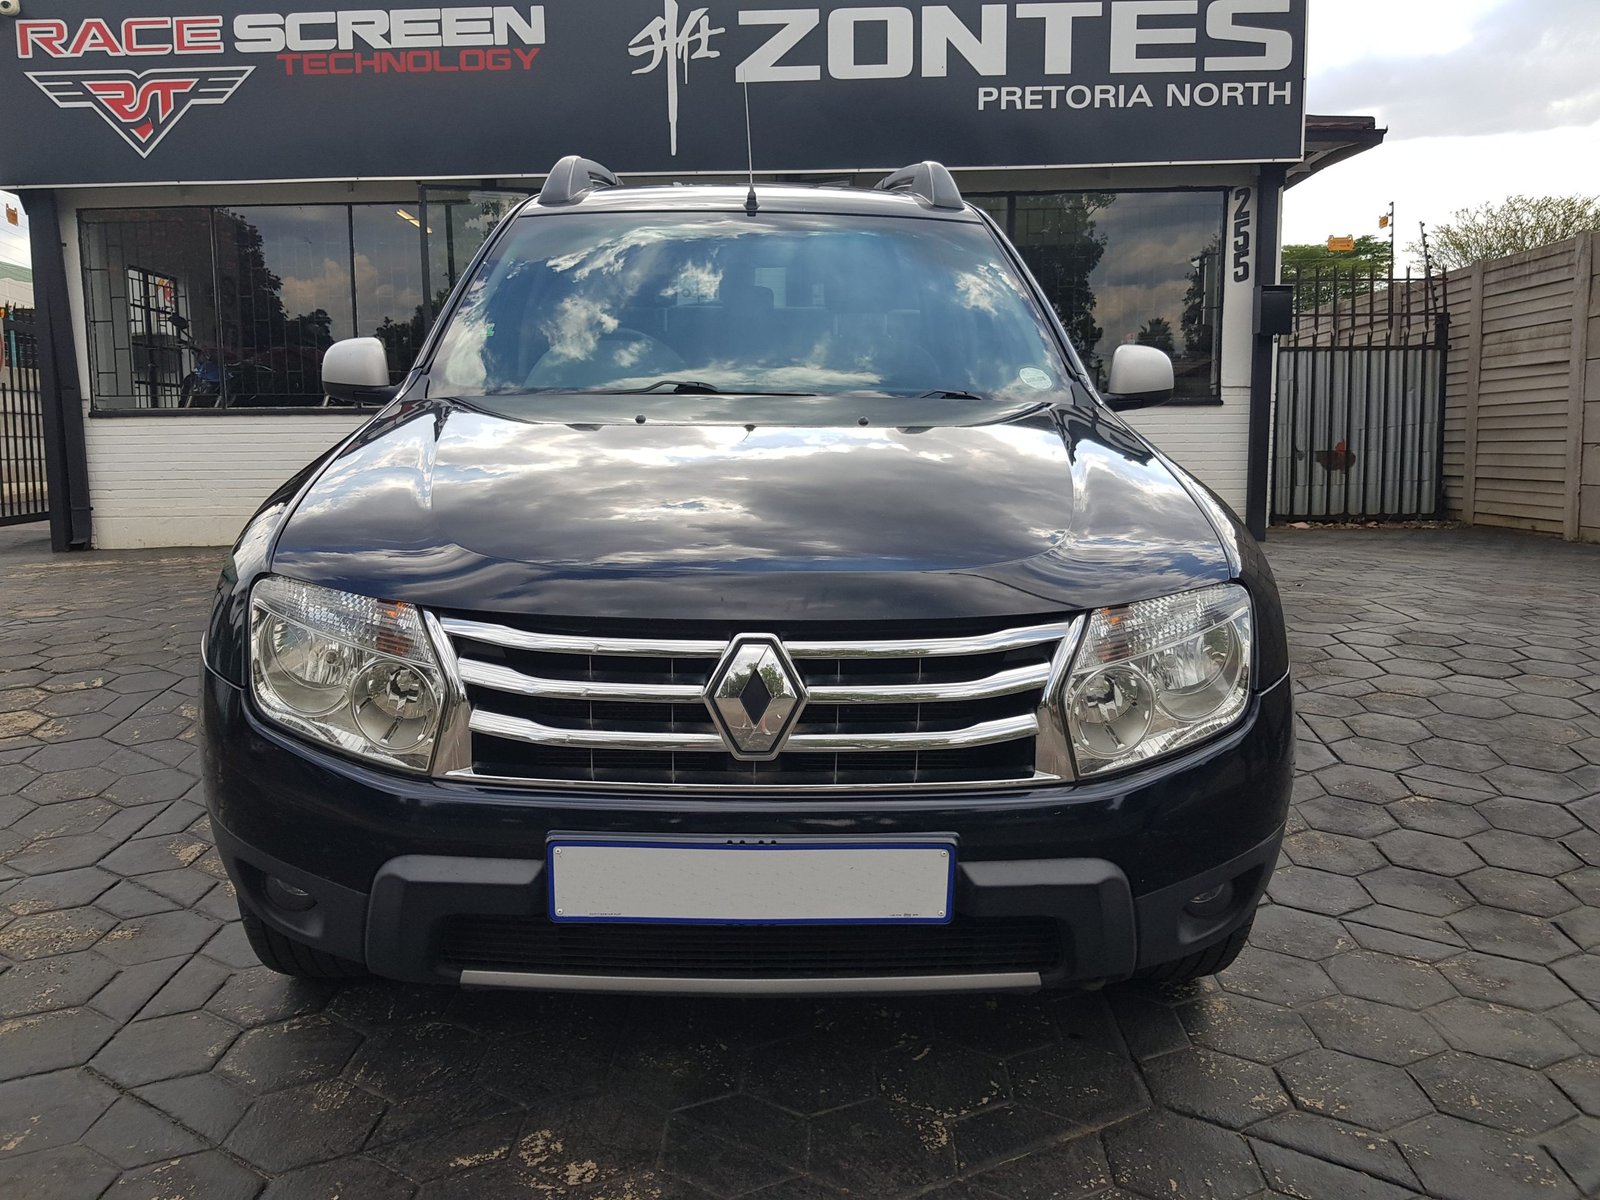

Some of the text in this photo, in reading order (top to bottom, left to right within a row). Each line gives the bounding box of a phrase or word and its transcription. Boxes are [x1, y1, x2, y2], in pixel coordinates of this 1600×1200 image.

[15, 5, 547, 59] RACE SCREEN
[735, 0, 1293, 83] ZONTES
[277, 48, 540, 76] TECHNOLOGY
[977, 81, 1292, 111] PRETORIA NORTH
[1233, 186, 1252, 283] 255
